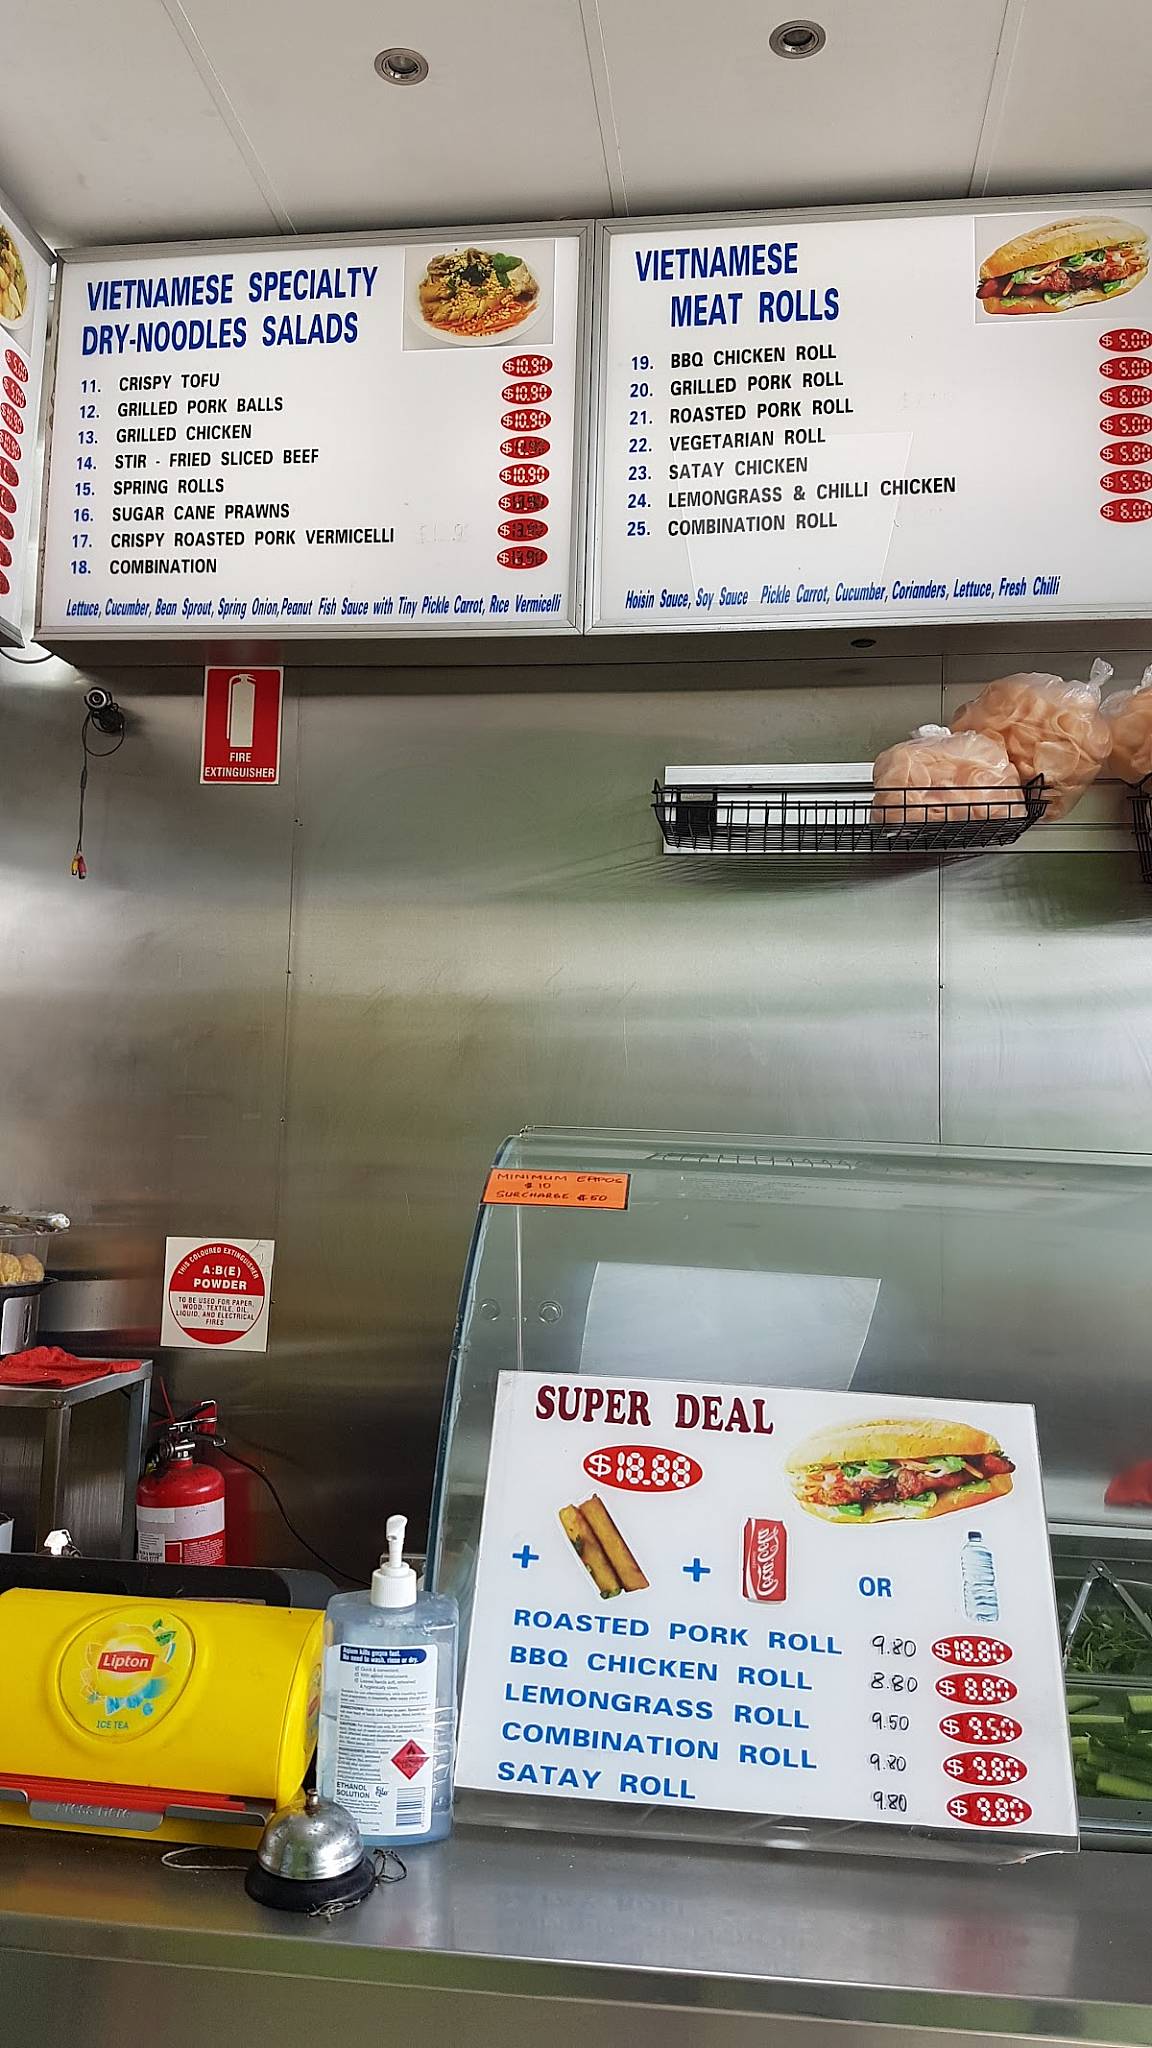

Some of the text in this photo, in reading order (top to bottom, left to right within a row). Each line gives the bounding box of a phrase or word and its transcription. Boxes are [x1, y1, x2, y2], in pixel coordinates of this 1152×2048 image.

[636, 243, 797, 281] VIETNAMESE
[88, 267, 378, 311] VIETNAMESE SPECIALTY
[671, 288, 839, 327] MEAT ROLLS
[82, 312, 357, 355] DRY-NOODLES SALADS
[504, 358, 548, 373] $10.90
[632, 344, 836, 370] 19. BBQ CHICKEN ROLL
[82, 373, 219, 393] 11. CRISPY TOFU
[503, 385, 547, 401] $10.90
[630, 371, 843, 397] 20. GRILLED PORK ROLL
[80, 397, 282, 418] 12. GRILLED PORK BALLS
[630, 398, 853, 425] 21. ROASTED PORK ROLL
[502, 412, 546, 428] $10.90
[79, 425, 251, 444] 13. GRILLED CHICKEN
[629, 428, 825, 452] 22. VEGETARIAN ROLL
[77, 449, 318, 470] 14. STIR FRIED SLICED BEEF
[629, 457, 807, 480] 23. SATAY CHICKEN
[501, 467, 545, 483] $10.90
[76, 479, 223, 496] 15. SPRING ROLLS
[628, 477, 955, 508] 24. LEMONGRASS & CHILLI CHICKEN
[74, 504, 289, 521] 16. SUGAR CANE PRAWNS
[628, 512, 837, 536] 25. COMBINATION ROLL
[73, 528, 393, 548] 17. CRISPY ROASTED PORK VERMICELLI
[71, 559, 216, 574] 18. COMBINATION
[626, 576, 1060, 610] Hoisin Sauce, Soy Sauce Pickle Carrot, Cucumber, Corianders, Lettuce, Fresh Chilli
[67, 594, 561, 619] Lettuce, Cucumber, Bean Sprout, Spring Fish Sauce with Tiny Pickle Carrot, Rice Vermicelli
[229, 752, 251, 762] FIRE
[204, 767, 275, 778] EXTINGUISHER
[497, 1173, 567, 1181] MINIMUM
[496, 1191, 568, 1199] SURCHARGE
[177, 1246, 259, 1279] THIS COLOURED EXTINGUISHER
[193, 1278, 247, 1290] POWDER
[198, 1297, 215, 1305] USED
[205, 1318, 224, 1326] FIRES
[536, 1385, 773, 1434] SUPER DEAL
[587, 1451, 691, 1488] $18.88
[859, 1577, 891, 1597] OR
[514, 1609, 842, 1654] ROASTED PORK ROLL
[871, 1635, 917, 1657] 9.80
[103, 1654, 148, 1669] Lipton
[511, 1646, 812, 1690] BBQ CHICKEN ROLL
[871, 1672, 918, 1692] 8.80
[506, 1683, 809, 1728] LEMONGRASS ROLL
[113, 1721, 129, 1729] TEA
[872, 1712, 909, 1731] 9.50
[503, 1723, 816, 1768] COMBINATION ROLL
[337, 1782, 367, 1791] ETHANOL
[498, 1762, 695, 1799] SATAY ROLL
[336, 1789, 370, 1798] SOLUTION
